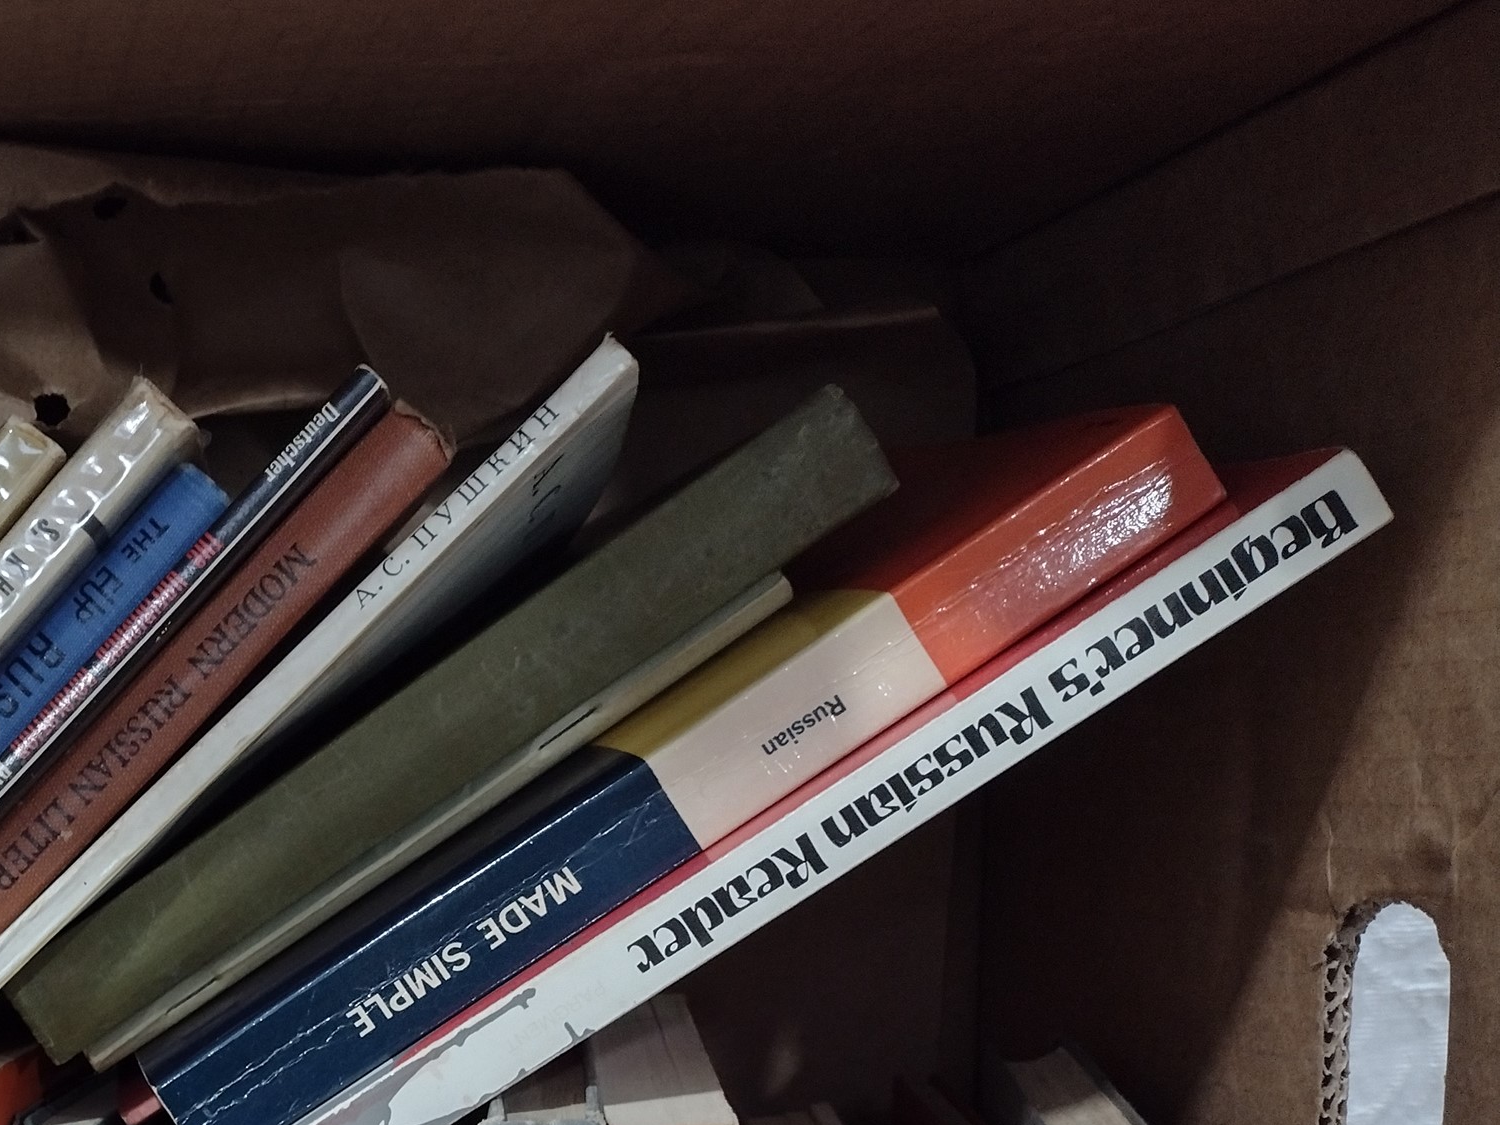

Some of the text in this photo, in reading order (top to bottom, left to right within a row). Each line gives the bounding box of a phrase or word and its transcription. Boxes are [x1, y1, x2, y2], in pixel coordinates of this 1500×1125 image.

[261, 400, 341, 483] Deutscher
[409, 403, 560, 553] ПУШКИН
[118, 511, 171, 566] THE
[191, 542, 318, 685] MODERN
[71, 671, 195, 812] RUSSIAN
[625, 490, 1358, 975] Beginner's Russian Reader
[760, 693, 849, 760] Russian
[345, 865, 584, 1039] MADE SIMPLE
